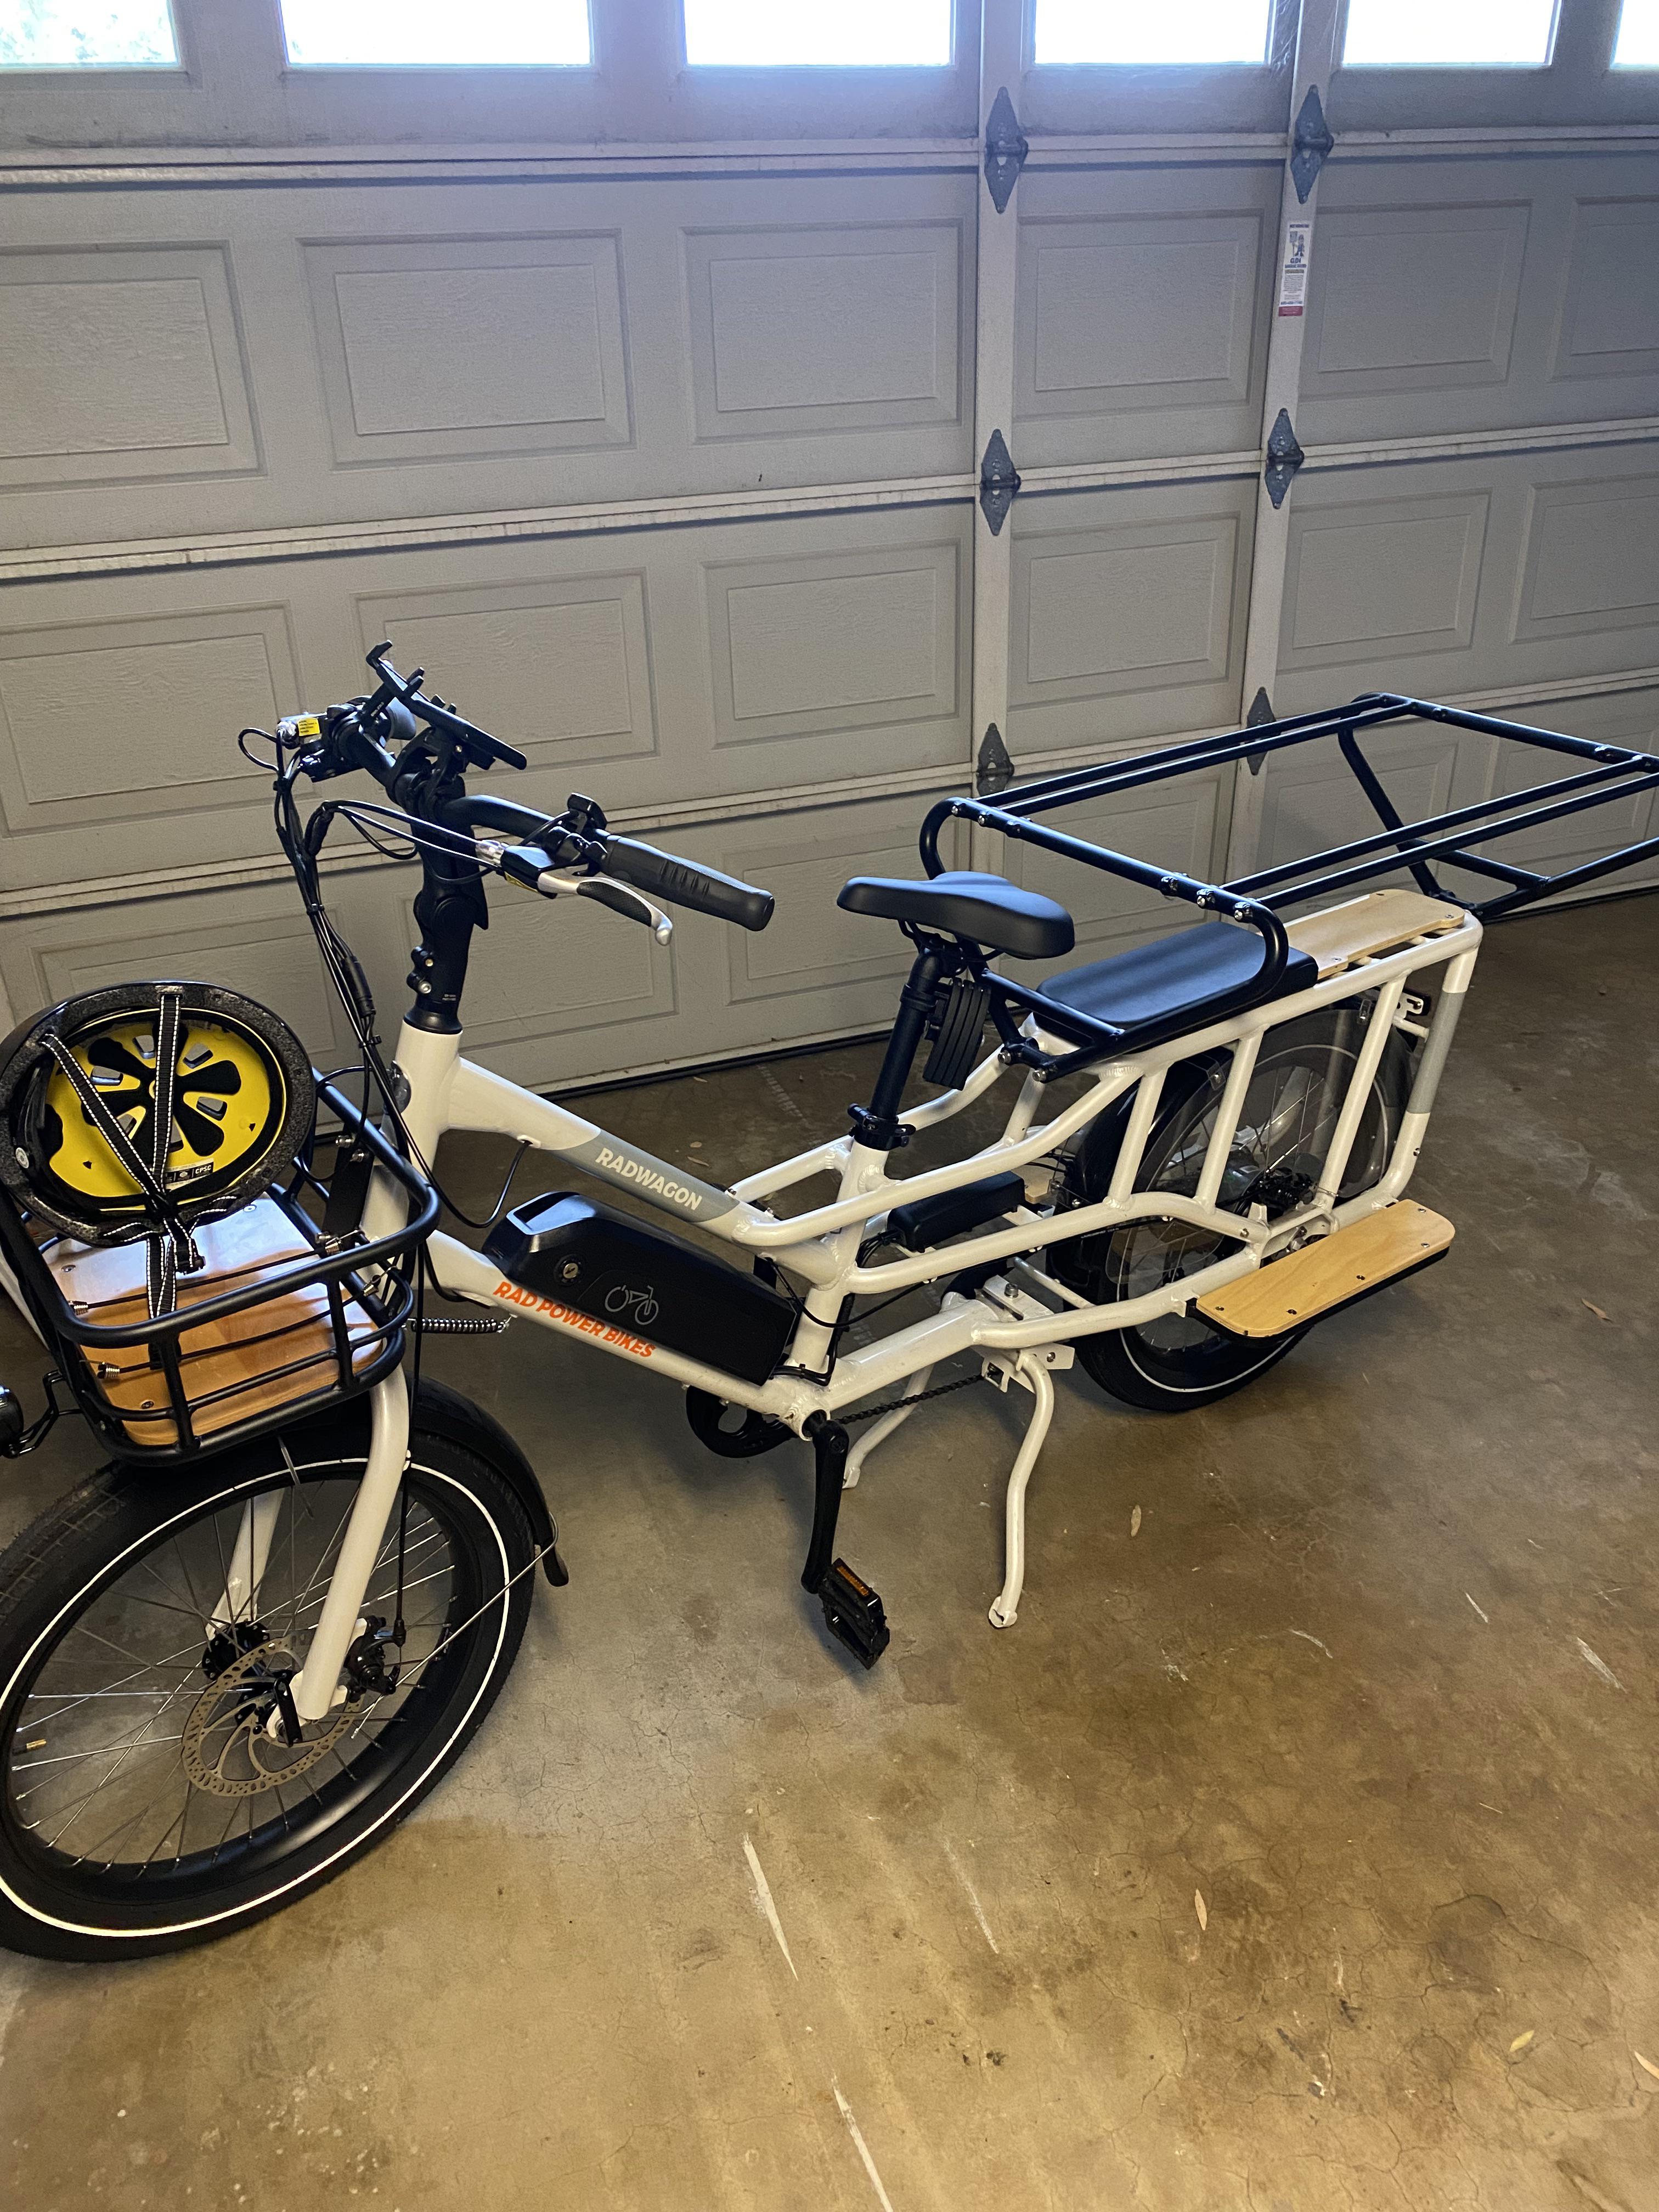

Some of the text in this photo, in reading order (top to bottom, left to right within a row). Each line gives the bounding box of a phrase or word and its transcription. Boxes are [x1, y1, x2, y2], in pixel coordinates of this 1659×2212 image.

[195, 1165, 212, 1174] CPSC
[595, 1147, 703, 1210] RADWAGON
[493, 1281, 656, 1357] RAD POWER BIKES
